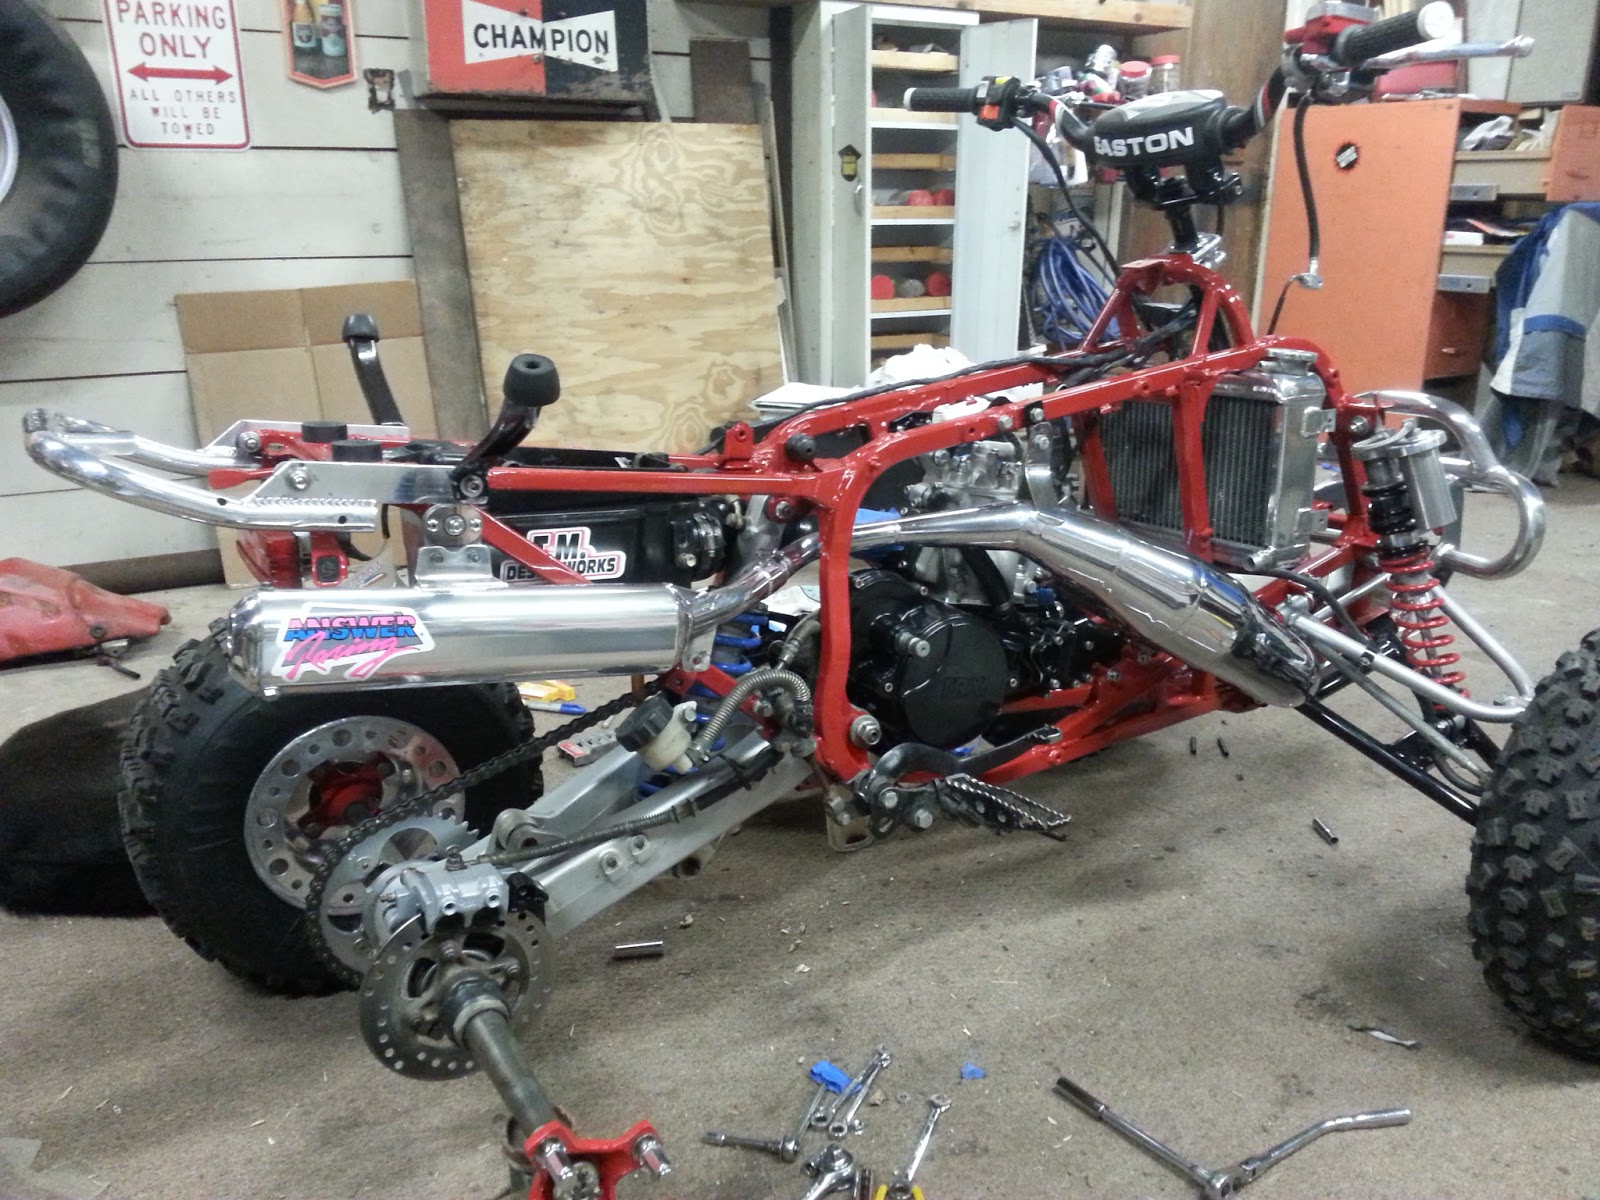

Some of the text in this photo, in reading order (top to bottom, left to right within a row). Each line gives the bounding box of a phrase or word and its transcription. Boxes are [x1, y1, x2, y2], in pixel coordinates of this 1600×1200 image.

[117, 0, 226, 29] PARKING
[139, 31, 211, 58] ONLY
[474, 23, 609, 54] CHAMPION
[130, 88, 236, 103] ALL OTHERS
[151, 106, 221, 119] WILL BE
[161, 121, 215, 135] TOWED
[1093, 126, 1195, 157] EASTON
[283, 614, 417, 641] ANSWER
